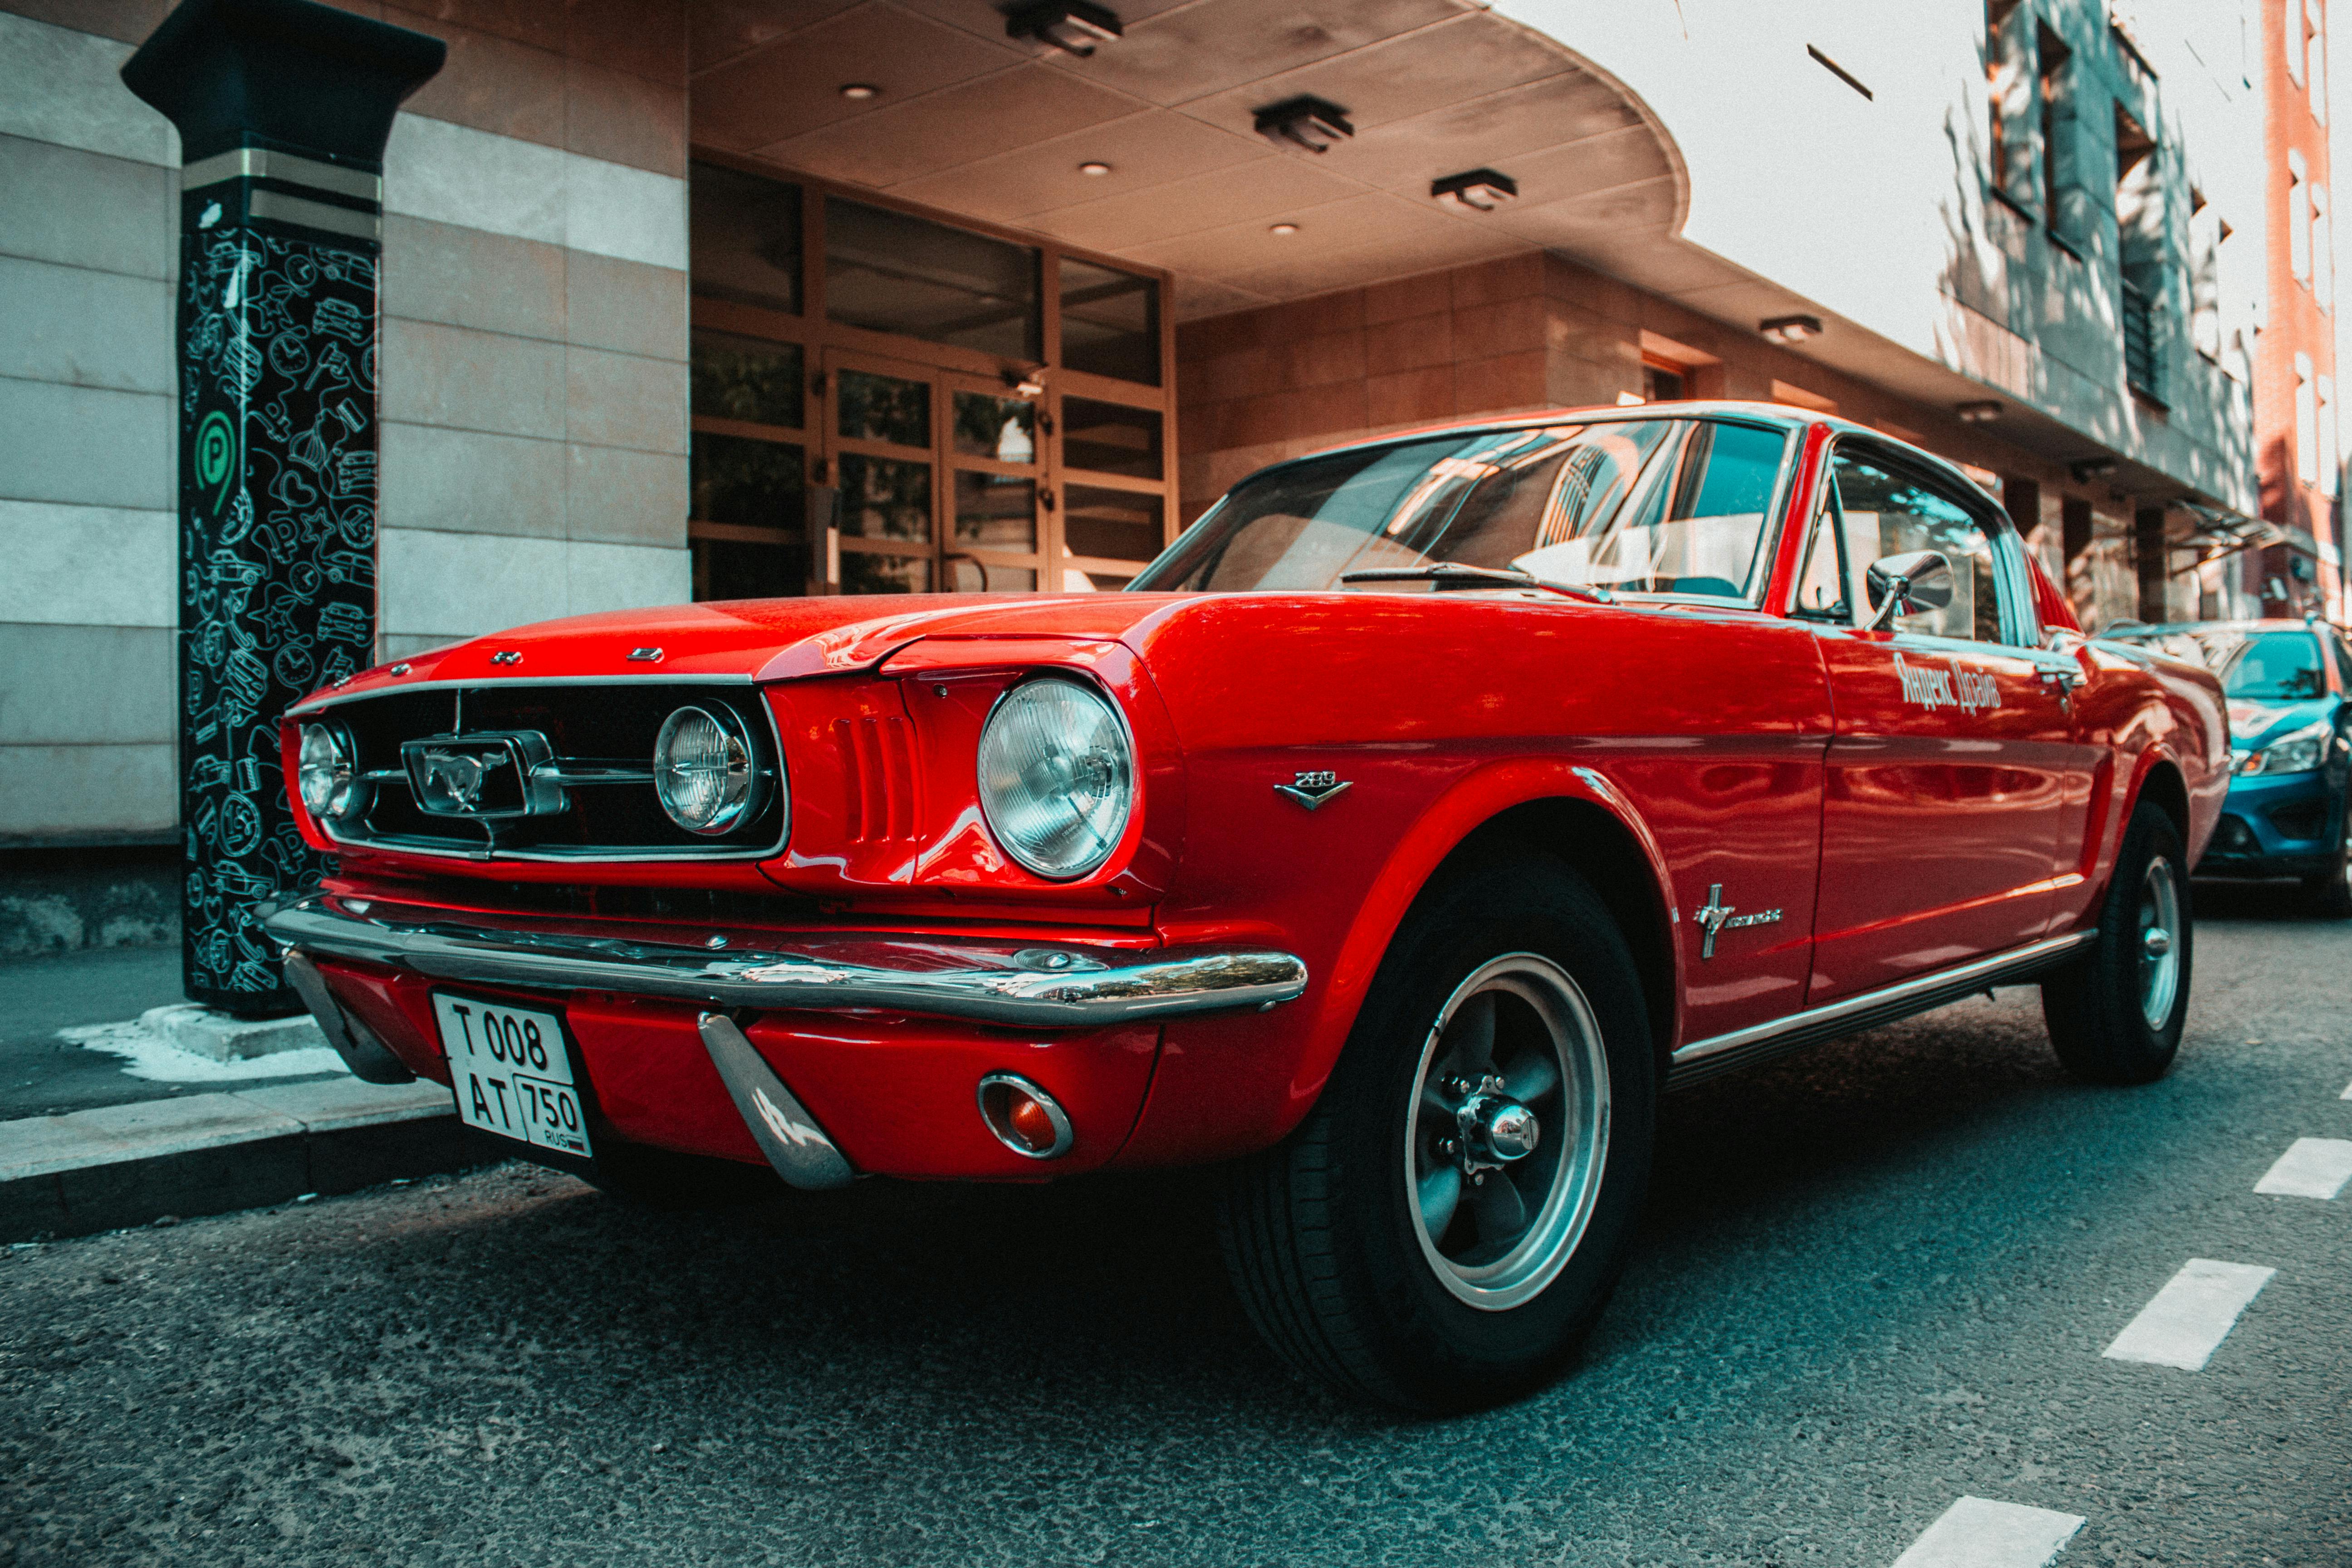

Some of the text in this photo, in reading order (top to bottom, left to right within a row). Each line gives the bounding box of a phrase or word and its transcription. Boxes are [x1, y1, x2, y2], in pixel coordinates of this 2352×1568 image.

[1893, 652, 2001, 717] Яндекс Драйв
[1295, 770, 1336, 788] 289
[483, 1010, 548, 1071] 008
[521, 1083, 578, 1132] 750
[544, 1130, 568, 1147] RUS
